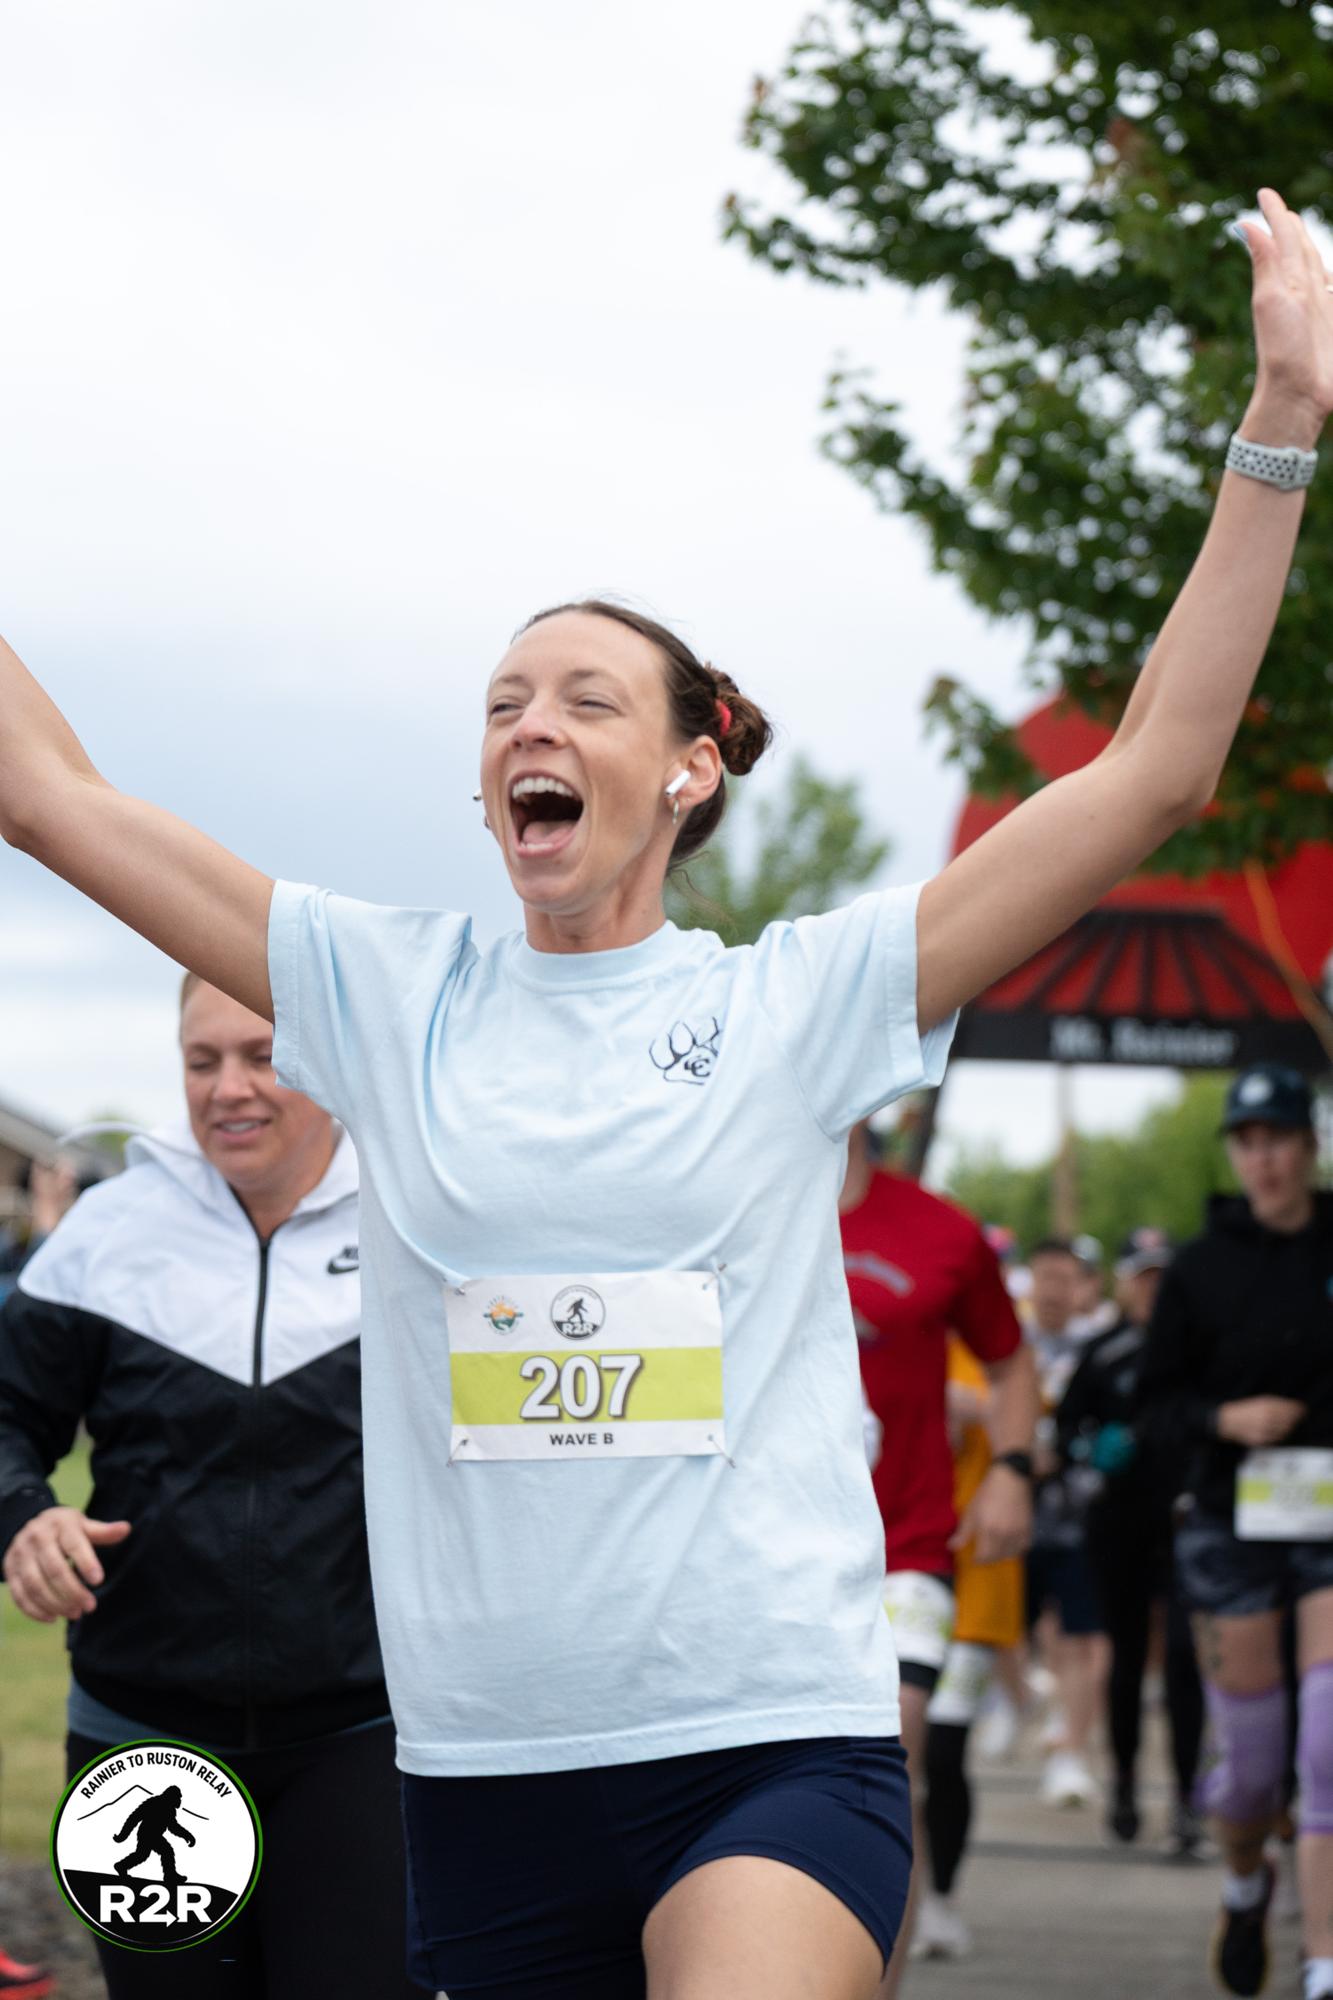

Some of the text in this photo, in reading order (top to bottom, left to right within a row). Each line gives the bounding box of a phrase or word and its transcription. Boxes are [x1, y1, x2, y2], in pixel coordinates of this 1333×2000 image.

[519, 1354, 645, 1422] 207
[550, 1432, 614, 1446] WAVE B
